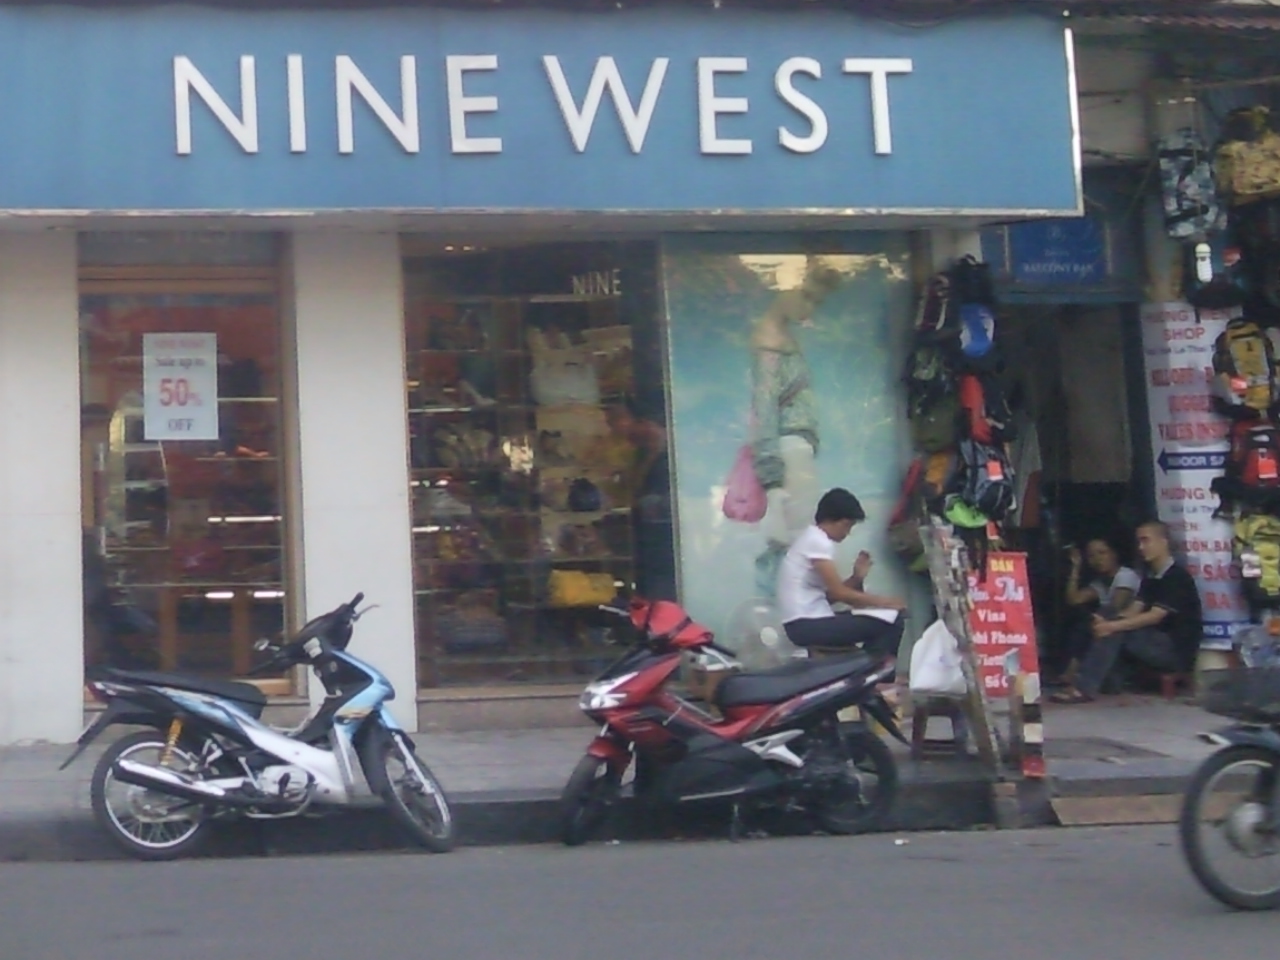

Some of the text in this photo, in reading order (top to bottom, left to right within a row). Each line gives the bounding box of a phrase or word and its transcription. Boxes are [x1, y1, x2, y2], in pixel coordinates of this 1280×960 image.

[174, 54, 913, 155] NINE WEST
[572, 269, 622, 295] NINE
[1163, 327, 1205, 341] SHOP
